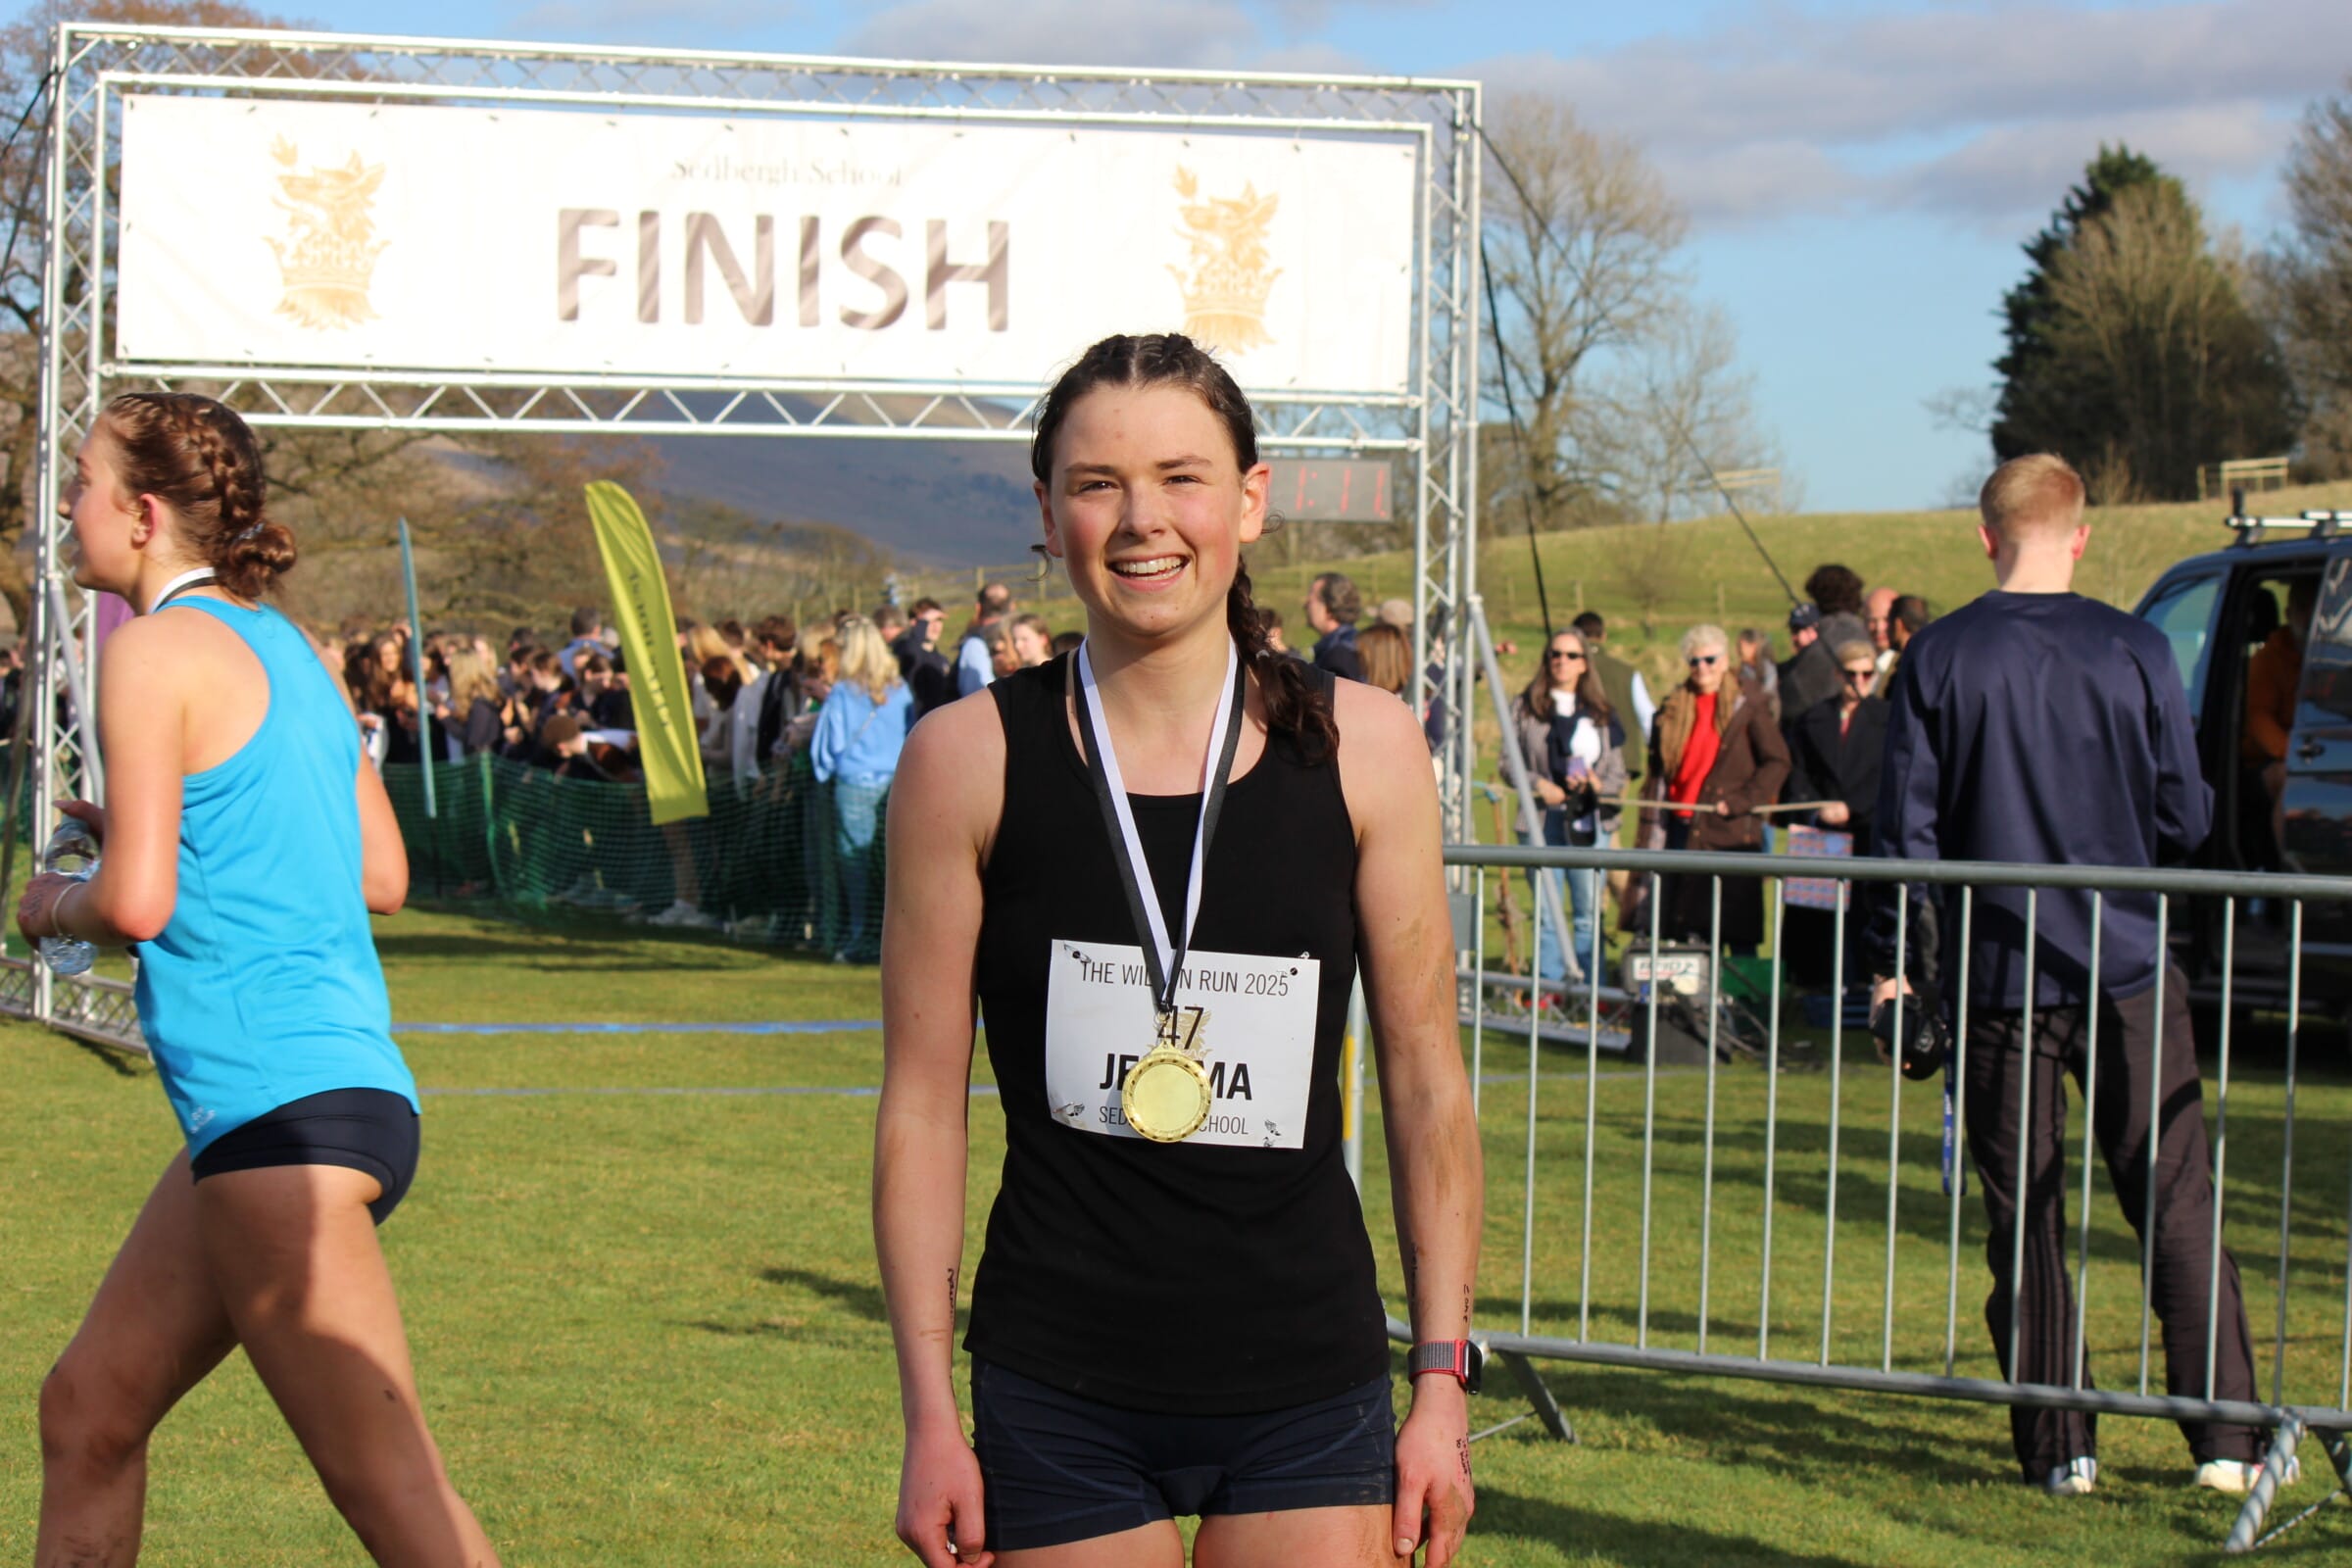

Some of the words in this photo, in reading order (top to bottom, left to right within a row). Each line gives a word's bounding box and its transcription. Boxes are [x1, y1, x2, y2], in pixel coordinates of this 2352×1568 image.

[558, 209, 1008, 332] FINISH
[1080, 960, 1116, 984] THE
[1122, 963, 1193, 990] WILN
[1199, 969, 1239, 994] RUN
[1244, 972, 1289, 997] 2025
[1157, 1004, 1204, 1051] 47
[1099, 1053, 1253, 1102] JEMA
